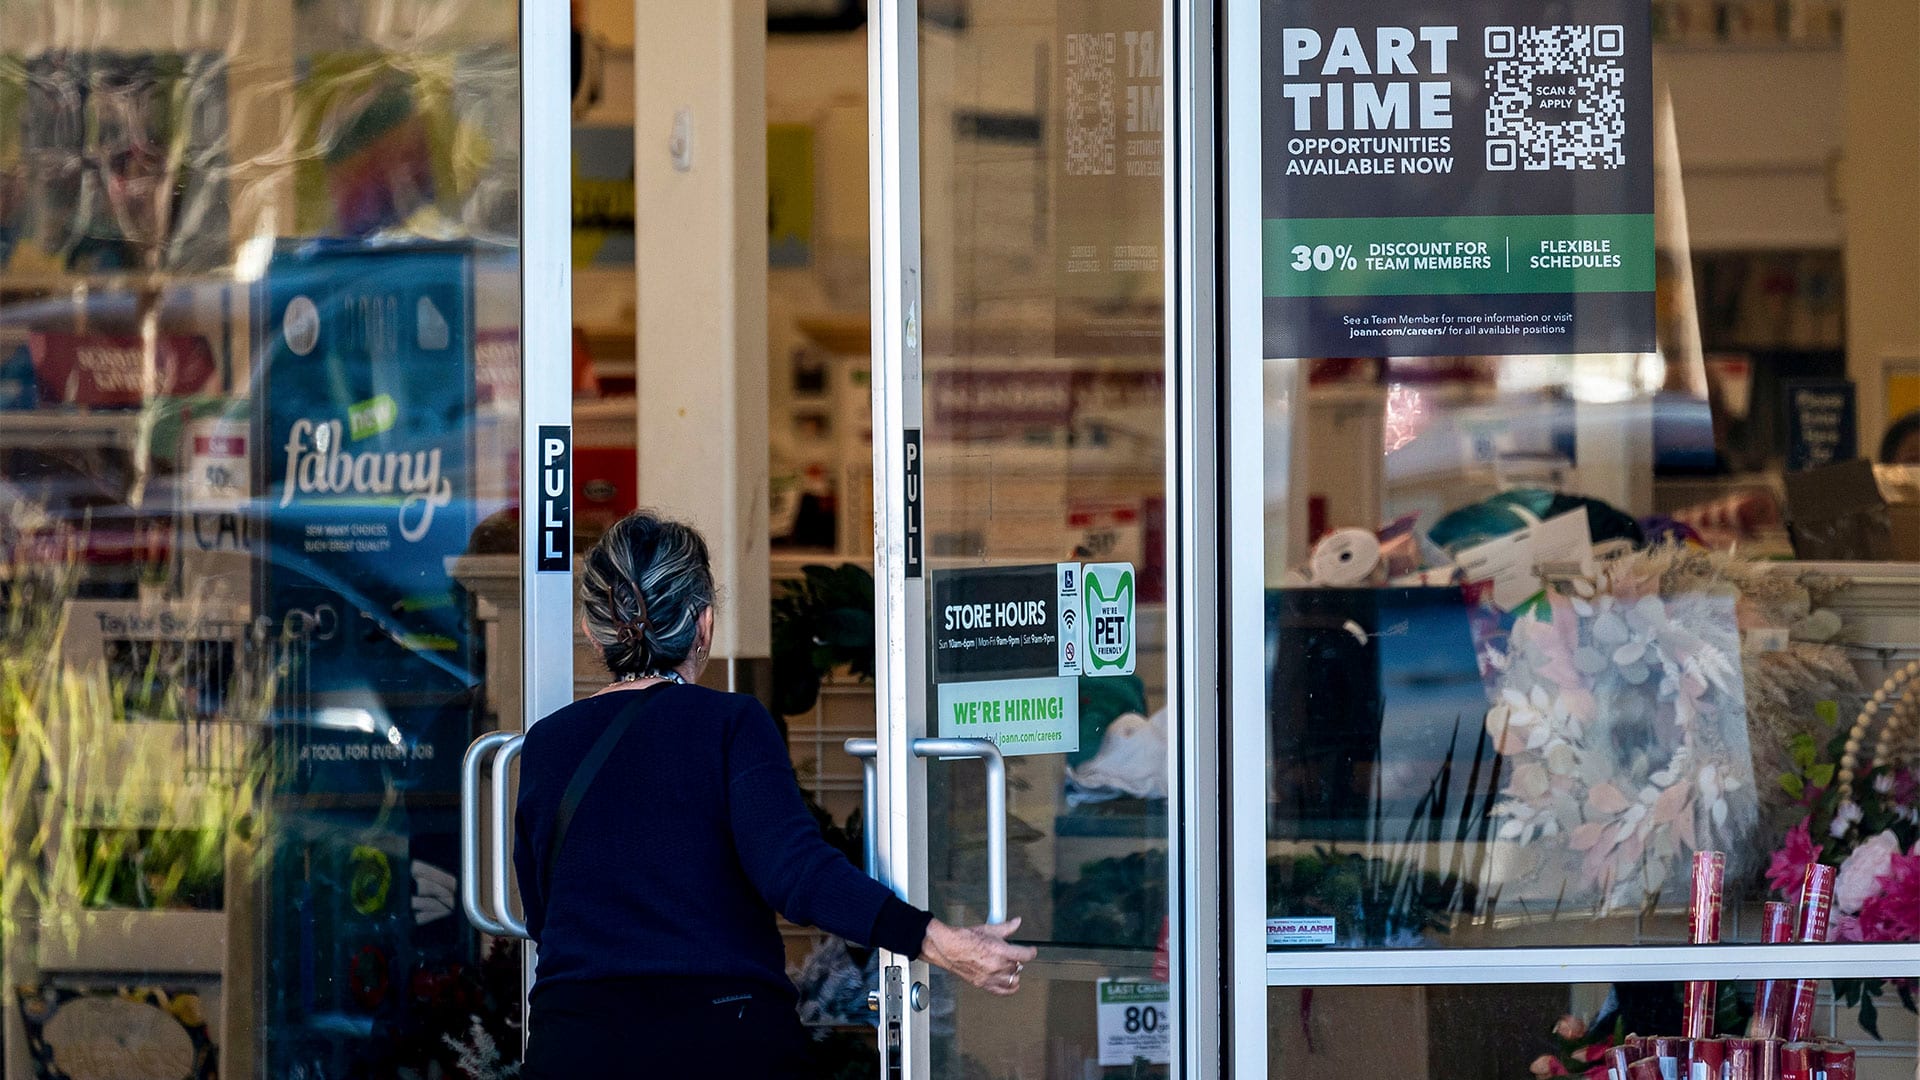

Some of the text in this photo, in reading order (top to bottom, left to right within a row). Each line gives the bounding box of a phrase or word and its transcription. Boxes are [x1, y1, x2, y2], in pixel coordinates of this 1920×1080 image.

[1282, 26, 1458, 76] PART
[1536, 85, 1577, 96] SCAN &
[1283, 81, 1453, 131] TIME
[1539, 99, 1573, 109] APPLY
[1287, 136, 1451, 155] OPPORTUNITIES
[1285, 156, 1454, 176] AVAILABLE NOW
[1369, 242, 1487, 257] DISCOUNT FOR
[1540, 239, 1611, 254] FLEXIBLE
[1290, 244, 1358, 272] 30%
[1365, 254, 1491, 271] TEAM MEMBERS
[1530, 254, 1621, 270] SCHEDULES
[1343, 312, 1573, 325] See a Team Member for more information or visit
[1349, 323, 1566, 338] joann.com/careers/ for all available positions
[544, 438, 565, 558] PULL
[906, 443, 918, 564] PULL
[945, 600, 1046, 630] STORE HOURS
[1102, 606, 1118, 615] WE'RE
[1095, 616, 1125, 645] PET
[1098, 647, 1122, 655] FRIENDLY
[953, 697, 1063, 725] WE'RE HIRING!
[1298, 925, 1333, 933] ALARM
